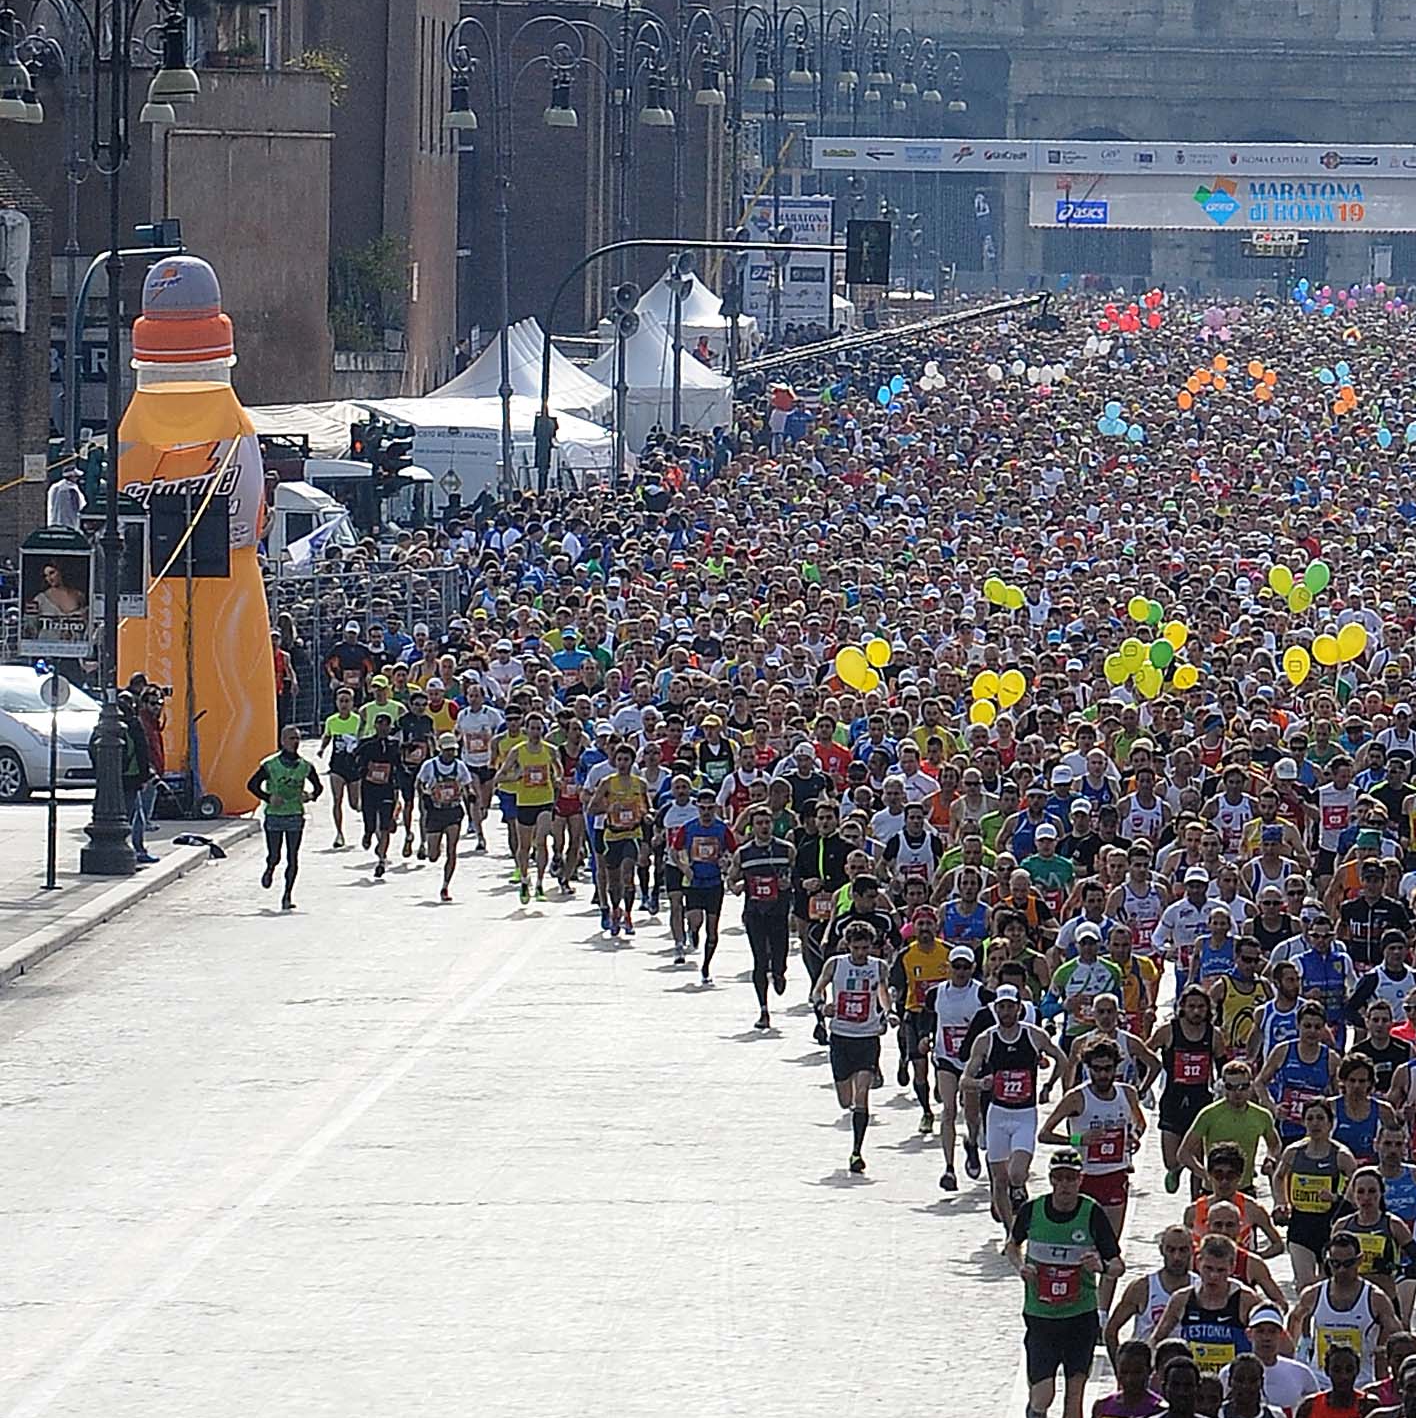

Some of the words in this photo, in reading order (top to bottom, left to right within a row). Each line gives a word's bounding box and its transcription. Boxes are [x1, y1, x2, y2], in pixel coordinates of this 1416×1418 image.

[1249, 182, 1365, 202] MARATONA
[1250, 202, 1267, 222] di
[1273, 203, 1335, 222] ROMA
[1338, 203, 1365, 222] 19
[38, 618, 85, 631] Tiziano
[1004, 1081, 1022, 1093] 222
[1188, 1323, 1232, 1338] ESTONIA
